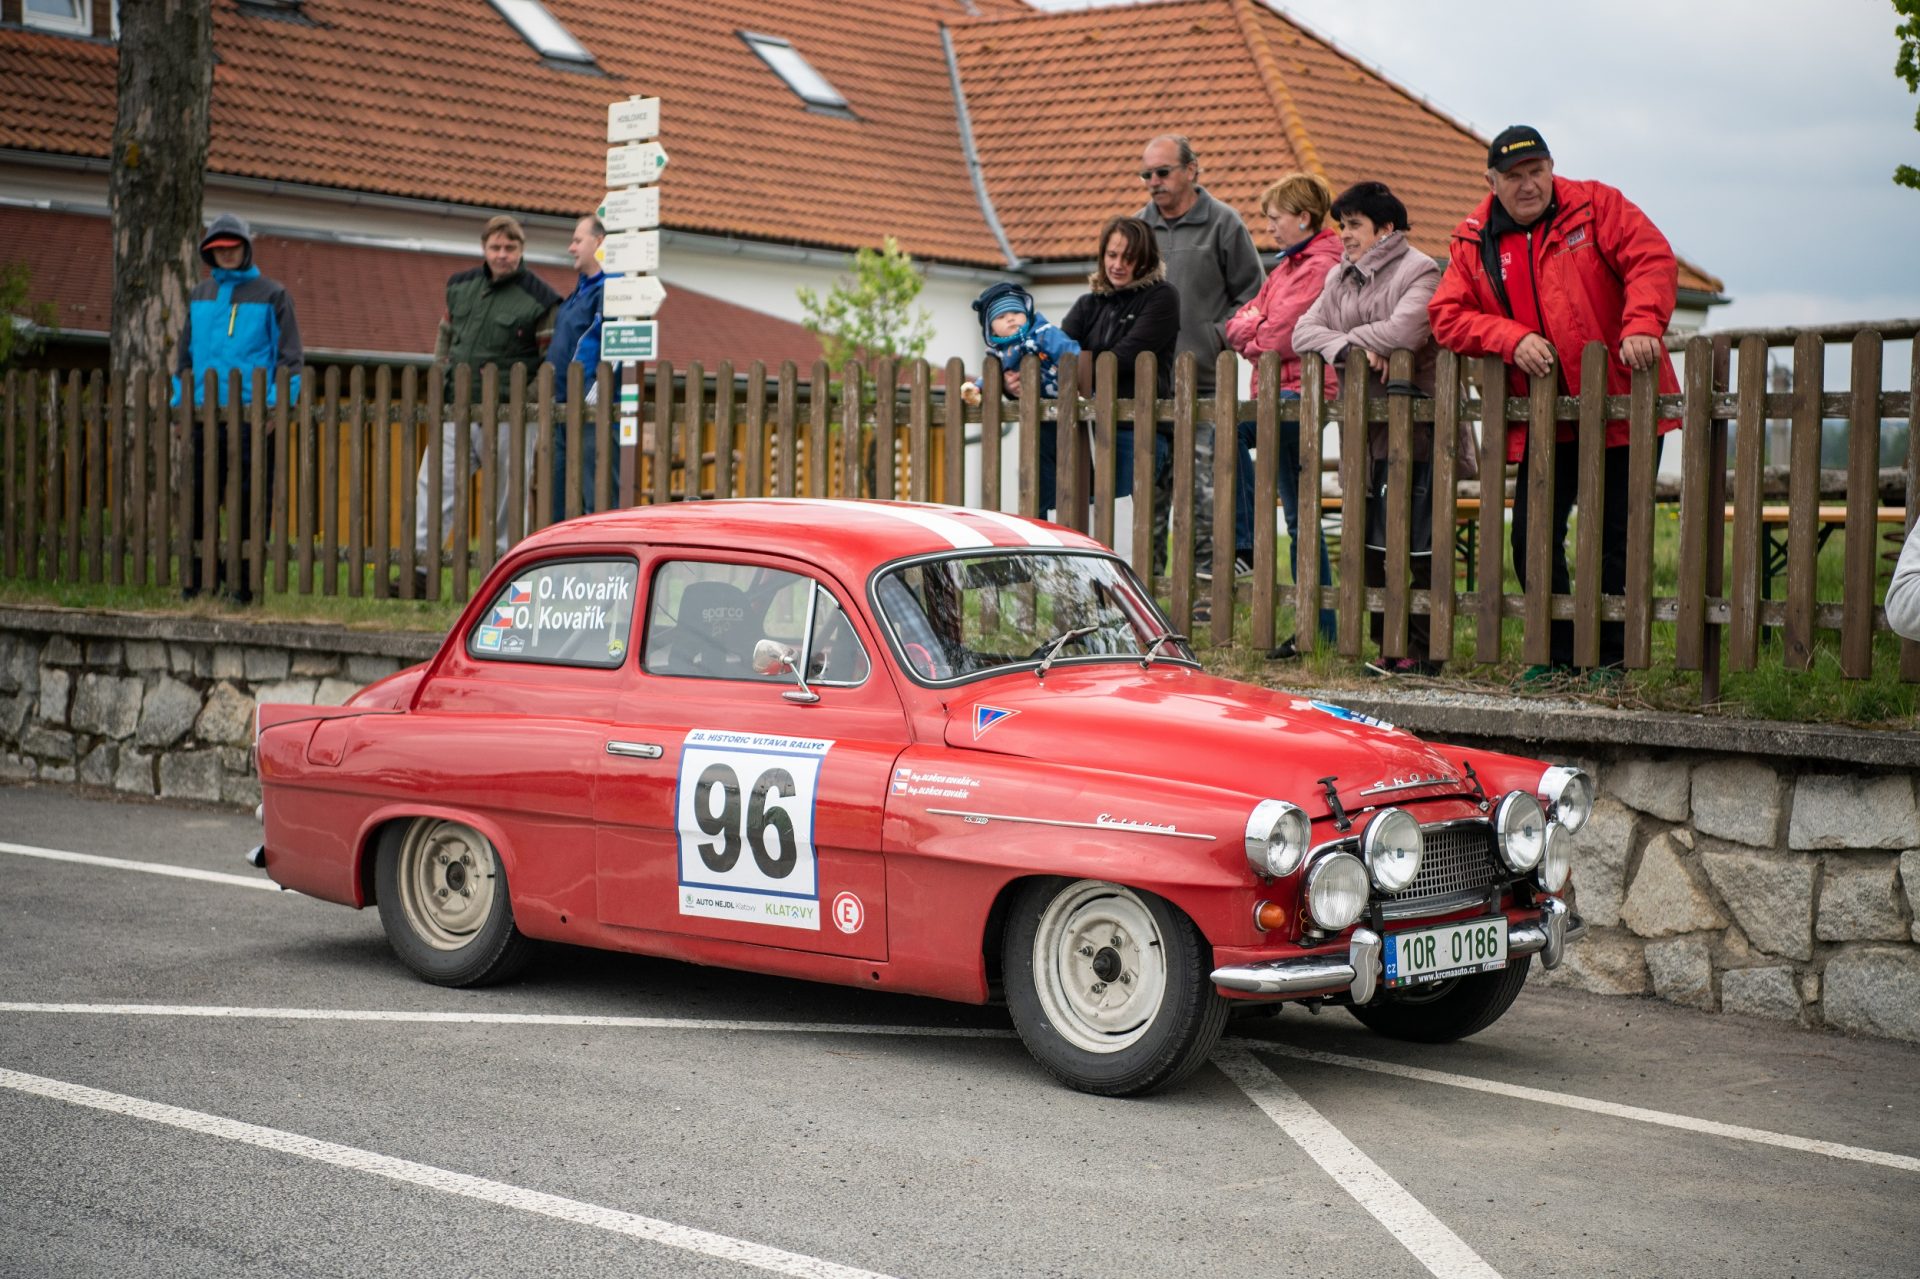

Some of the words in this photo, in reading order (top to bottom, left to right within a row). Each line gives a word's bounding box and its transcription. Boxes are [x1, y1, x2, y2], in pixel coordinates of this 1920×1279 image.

[538, 576, 556, 600] O.
[562, 576, 630, 601] Kovařík
[515, 606, 533, 630] O.
[538, 605, 607, 630] Kovařík
[702, 607, 744, 623] sparco
[691, 733, 705, 741] 20.
[707, 734, 751, 744] HISTORIC
[752, 738, 788, 747] VLTAVA
[694, 762, 798, 880] 96
[696, 898, 714, 907] AUTO
[714, 900, 735, 909] NEJDL
[765, 902, 814, 919] KLATOVY
[843, 902, 853, 923] E
[1402, 935, 1437, 972] 10R
[1451, 925, 1498, 963] 0186
[1386, 963, 1397, 975] CZ
[1418, 966, 1477, 983] www.krcmaauto.cz
